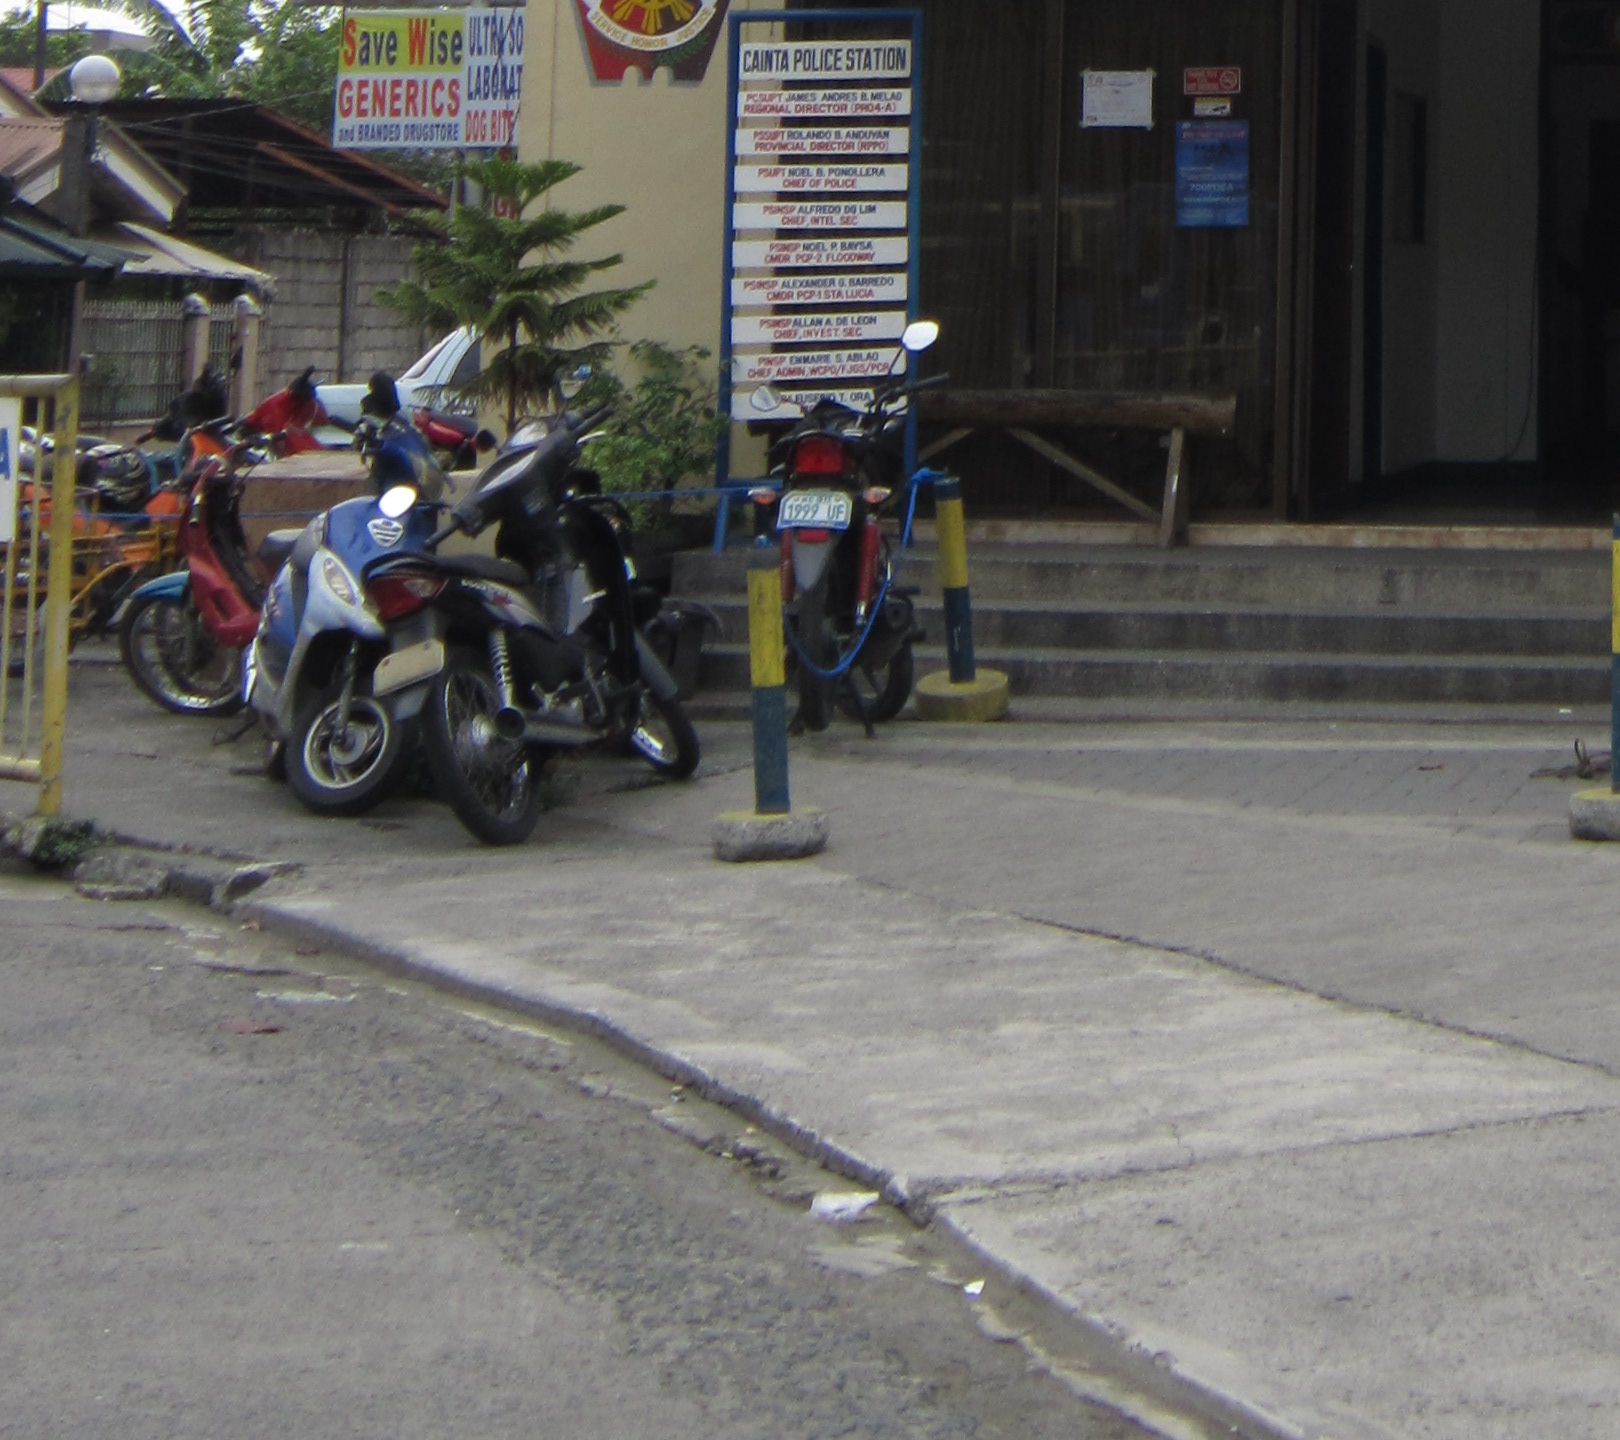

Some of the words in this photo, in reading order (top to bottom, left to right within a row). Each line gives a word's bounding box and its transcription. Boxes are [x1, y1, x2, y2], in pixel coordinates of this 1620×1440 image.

[343, 18, 398, 66] Save
[408, 17, 463, 66] Wise
[743, 49, 789, 72] CAINTA
[794, 48, 843, 72] POLICE
[846, 46, 907, 71] STATION
[338, 78, 461, 118] GENERICS
[785, 92, 817, 102] JAMES
[821, 92, 858, 102] ANDRES
[744, 104, 791, 114] REGIONAL
[795, 103, 847, 113] DIRECTOR
[465, 109, 487, 143] DOG
[338, 124, 355, 142] and
[358, 124, 401, 142] BRANDED
[403, 123, 459, 142] DRUGSTORE
[787, 130, 831, 140] ROLANDO
[755, 141, 806, 152] PROVINCIAL
[810, 141, 855, 151] DIRECTOR
[788, 167, 812, 177] NOEL
[782, 179, 806, 188] CHIEF
[824, 178, 857, 188] POLICE
[797, 204, 841, 214] ALFREDO
[803, 242, 827, 251] NOEL
[780, 277, 836, 288] ALEXANDER
[846, 288, 874, 299] LUCIA
